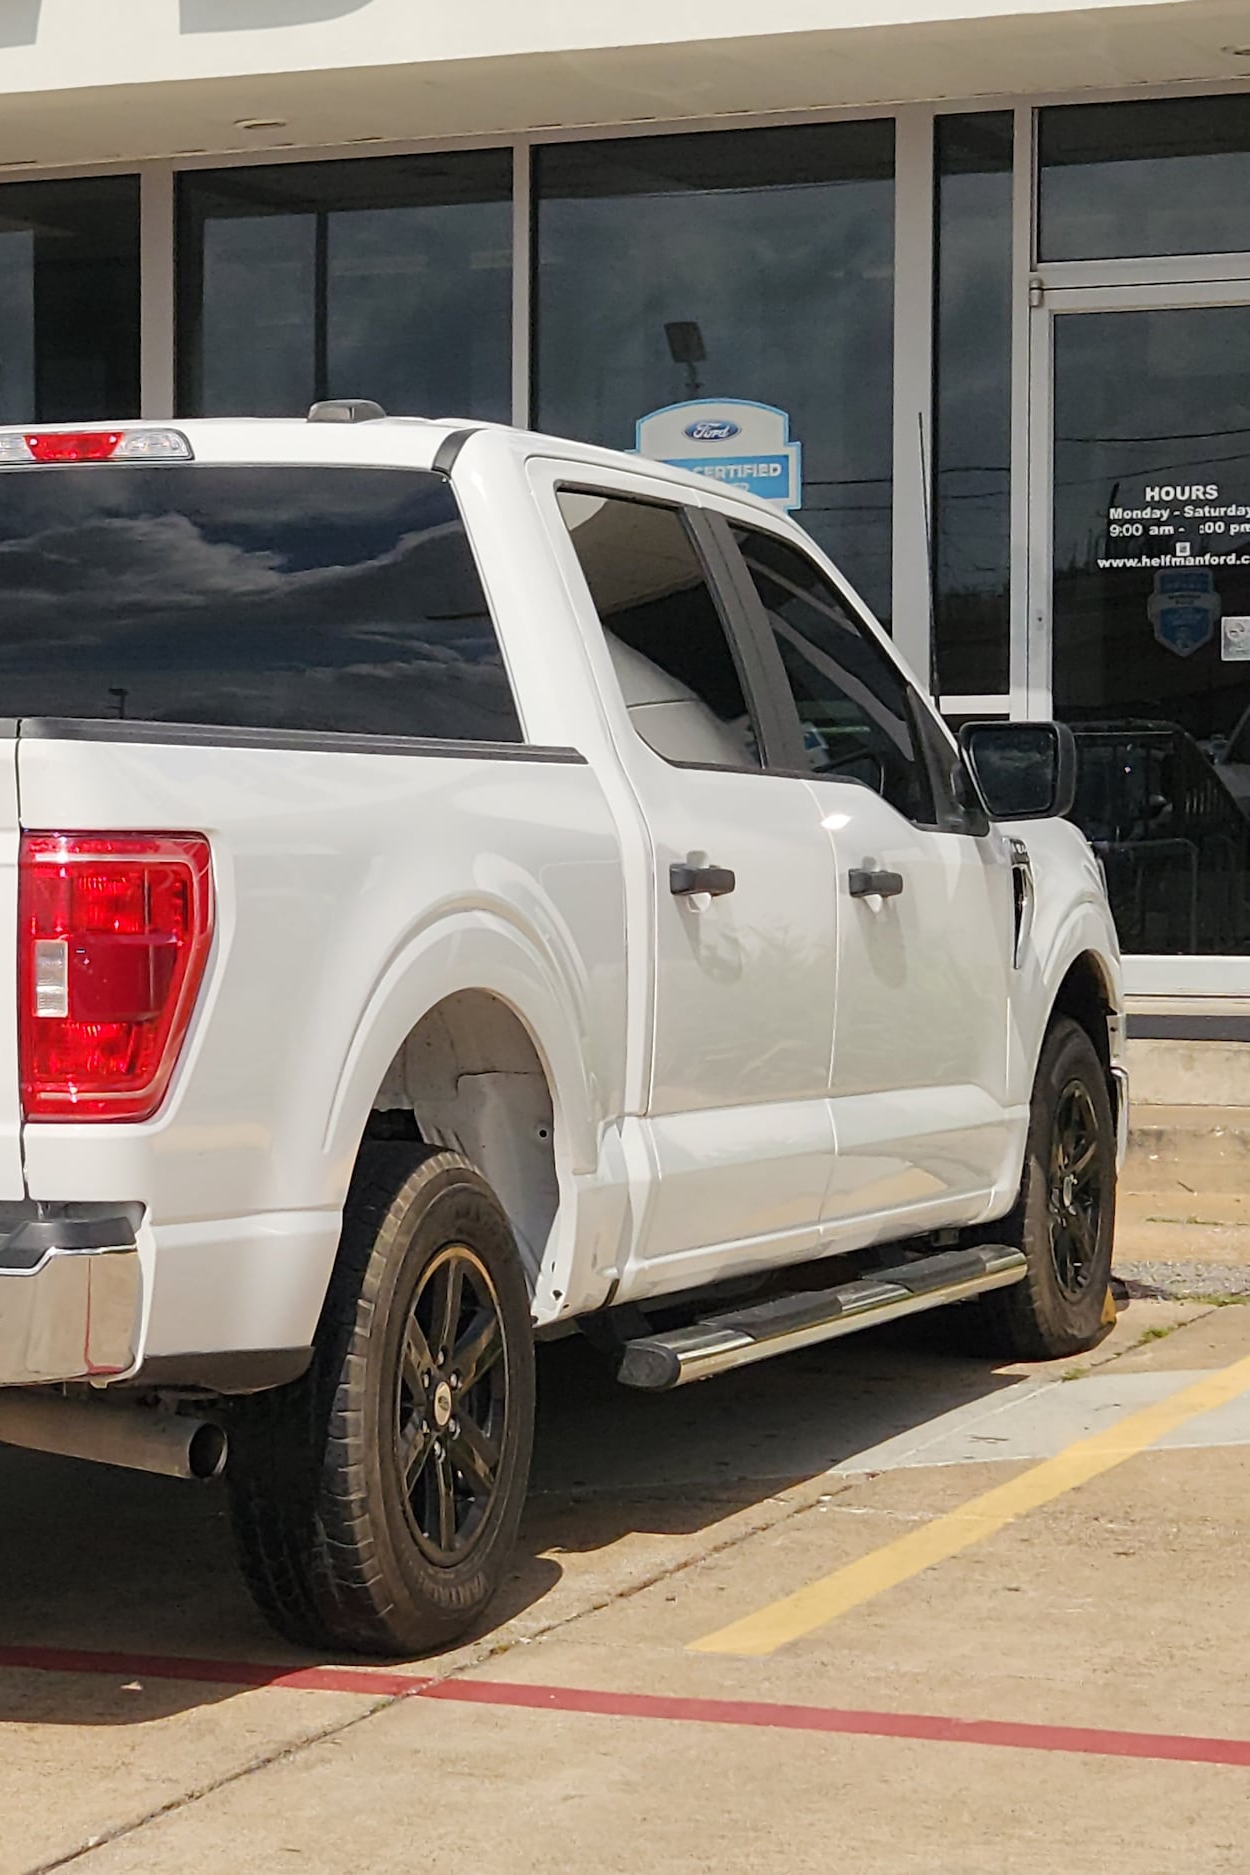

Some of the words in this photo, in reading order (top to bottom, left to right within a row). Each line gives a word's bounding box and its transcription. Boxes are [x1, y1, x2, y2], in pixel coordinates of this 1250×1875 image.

[693, 422, 730, 438] Ford
[1145, 484, 1219, 501] HOURS
[1109, 506, 1170, 521] Monday
[1109, 523, 1143, 537] 9:00
[1149, 525, 1175, 535] am
